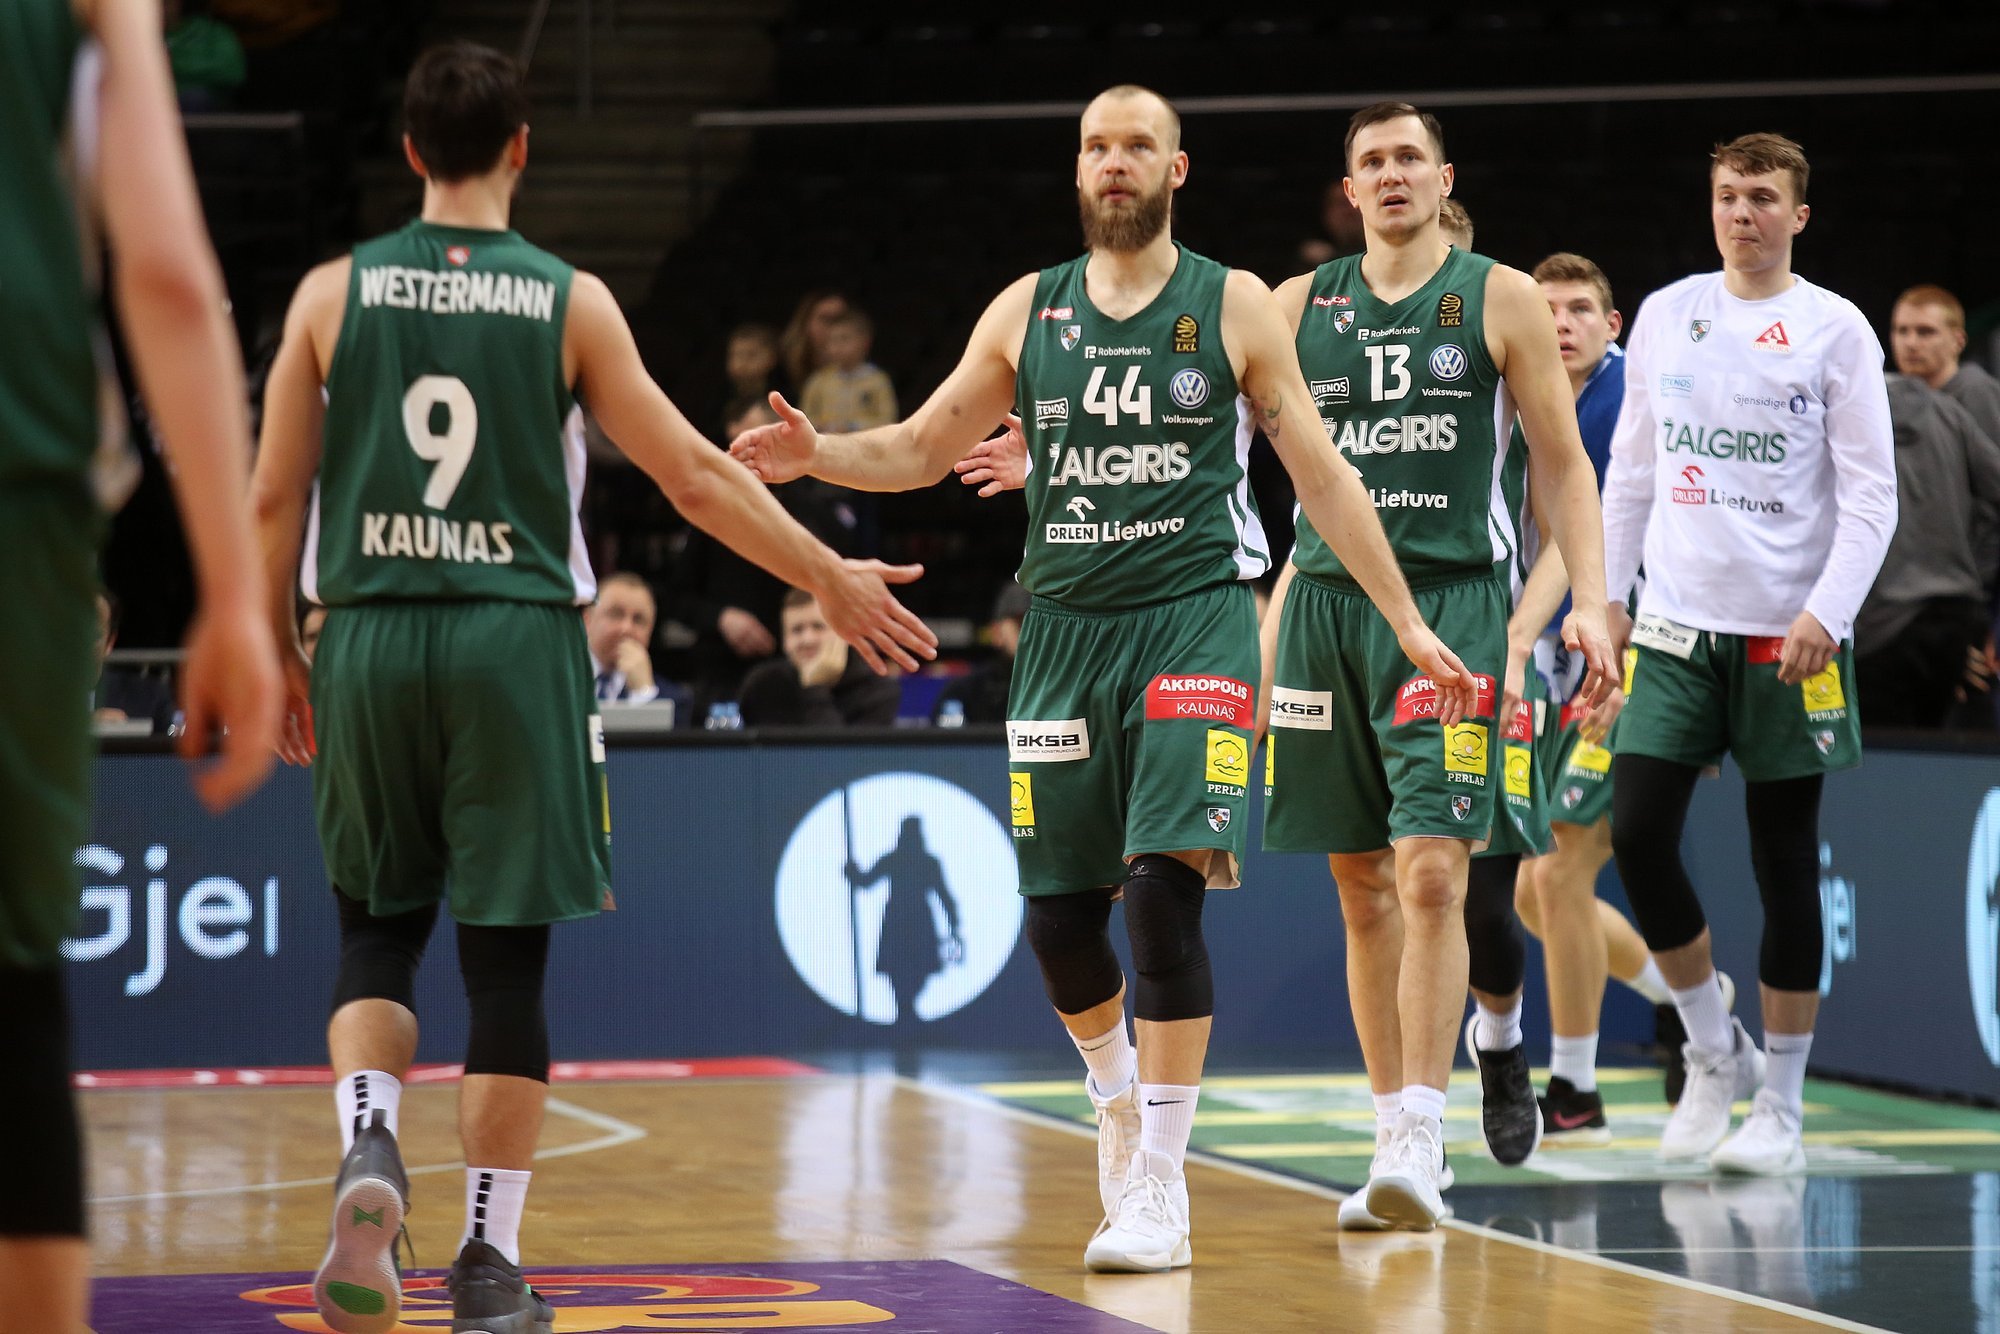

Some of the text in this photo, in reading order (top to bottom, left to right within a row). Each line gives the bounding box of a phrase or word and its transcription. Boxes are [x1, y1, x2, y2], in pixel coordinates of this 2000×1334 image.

[360, 265, 556, 323] WESTERMANN
[1370, 326, 1421, 339] RoboMarkets
[1441, 318, 1461, 327] LKL
[1098, 345, 1152, 357] RoboMarkets
[1176, 343, 1197, 352] LKL
[1364, 344, 1412, 402] 13
[1082, 365, 1152, 426] 44
[1313, 381, 1347, 396] UTENOS
[1421, 388, 1472, 399] Volkswagen
[1733, 393, 1787, 410] Gjensidige
[1162, 414, 1214, 425] Volkswagen
[402, 374, 478, 511] 9
[1663, 416, 1788, 465] ŽALGIRIS
[1049, 441, 1192, 486] ŽALGIRIS
[1369, 487, 1449, 509] Lietuva
[1673, 488, 1785, 514] ORLEN Lietuva
[362, 512, 514, 565] KAUNAS
[1049, 517, 1185, 543] ORLEN Lietuva
[1158, 678, 1249, 701] AKROPOLIS
[1176, 702, 1236, 721] KAUNAS
[1809, 710, 1846, 723] PERLAS
[1447, 772, 1485, 787] PERLAS
